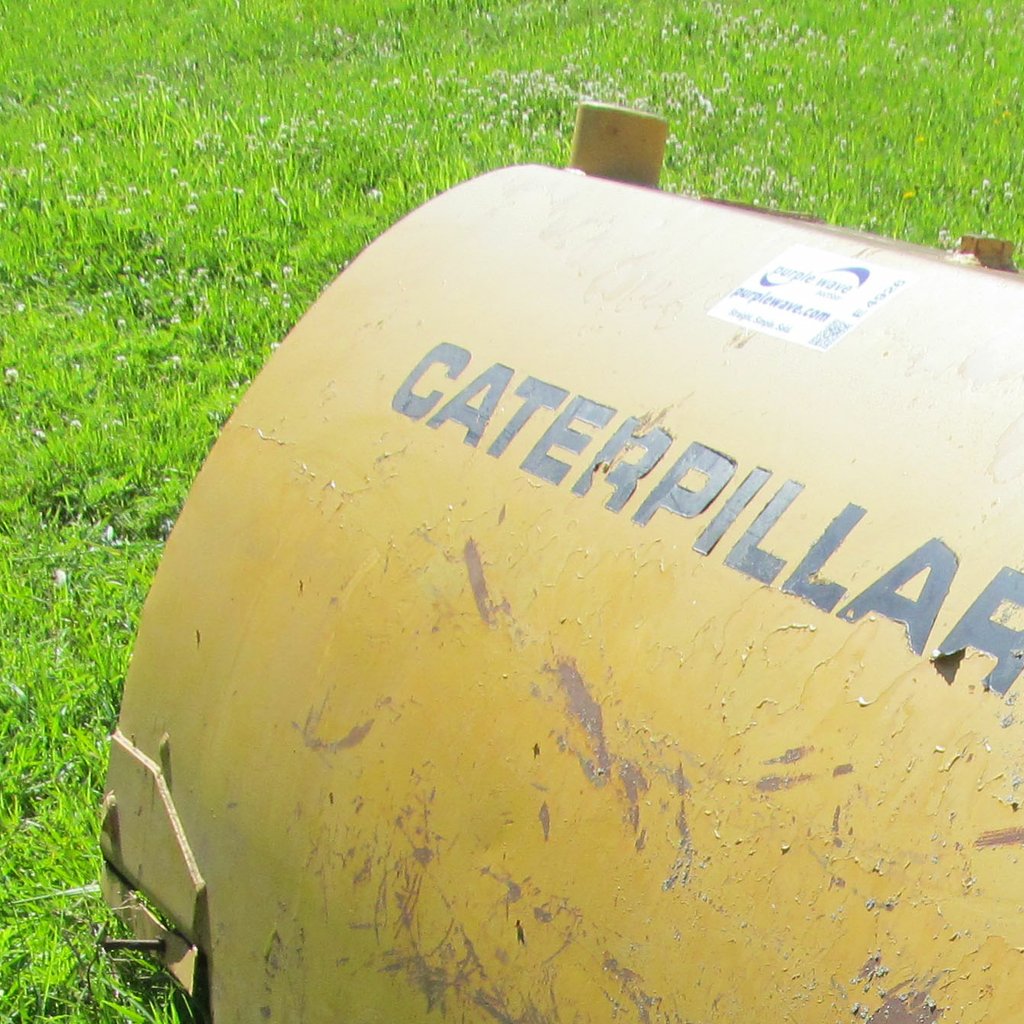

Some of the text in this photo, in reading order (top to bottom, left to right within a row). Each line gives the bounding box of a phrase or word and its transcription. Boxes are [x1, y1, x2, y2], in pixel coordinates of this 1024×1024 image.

[773, 265, 853, 295] purple wave
[731, 287, 832, 322] purplewave.com
